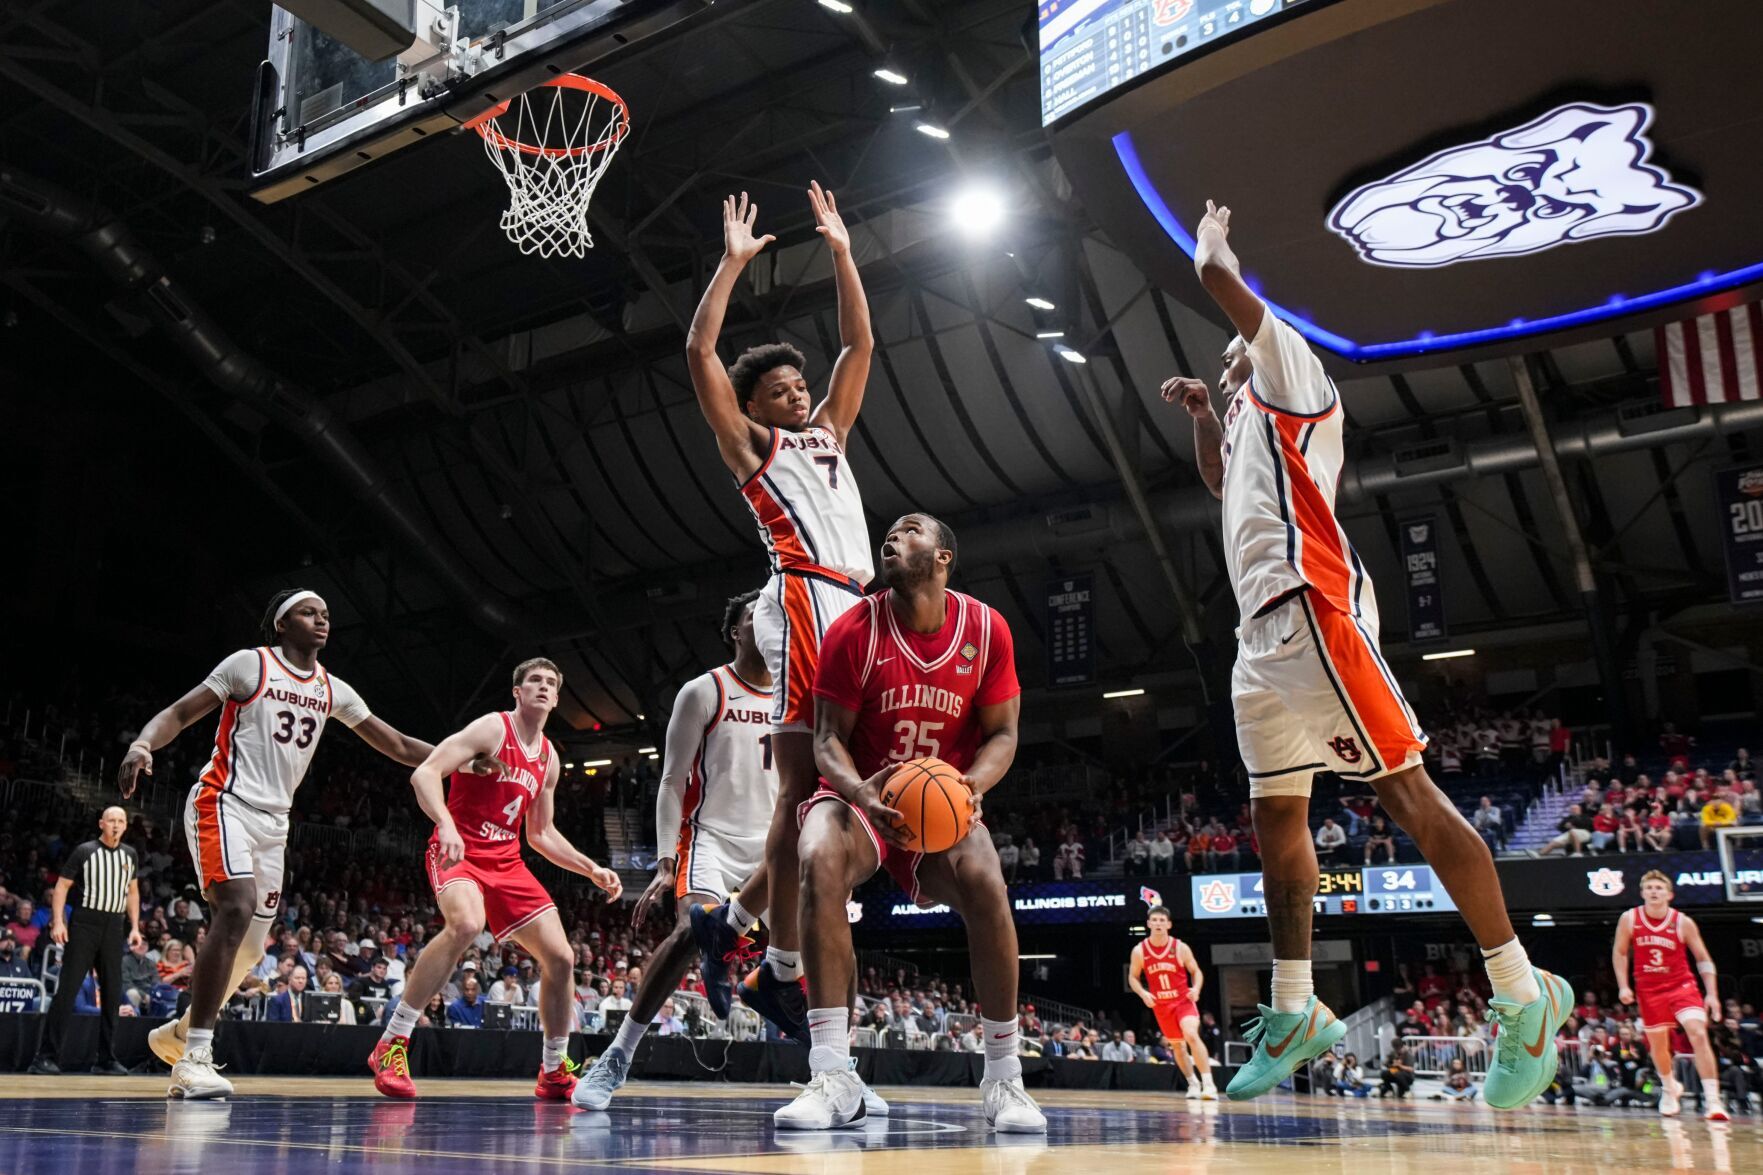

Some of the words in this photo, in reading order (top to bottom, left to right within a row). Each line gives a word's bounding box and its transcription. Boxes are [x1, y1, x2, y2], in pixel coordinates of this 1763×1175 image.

[1203, 22, 1213, 35] 3
[1228, 11, 1239, 23] 4
[1123, 31, 1132, 41] 0
[1138, 36, 1147, 46] 0
[1139, 49, 1148, 59] 0
[813, 455, 838, 490] 7
[1730, 499, 1763, 534] 20
[262, 687, 327, 714] AUBURN
[880, 684, 963, 718] ILLINOIS
[723, 708, 772, 726] AUBU
[272, 710, 316, 750] 33
[888, 720, 945, 761] 35
[758, 733, 773, 770] 1
[502, 794, 523, 826] 4
[1382, 870, 1416, 890] 34
[1676, 869, 1763, 886] AUBUR
[1015, 898, 1075, 911] ILLINOIS
[1077, 895, 1126, 907] STATE
[1386, 899, 1395, 910] 3
[1401, 899, 1411, 910] 3
[1649, 949, 1663, 966] 3
[1159, 974, 1171, 991] 11
[0, 987, 33, 1000] ECTION
[1157, 990, 1179, 1000] STATE
